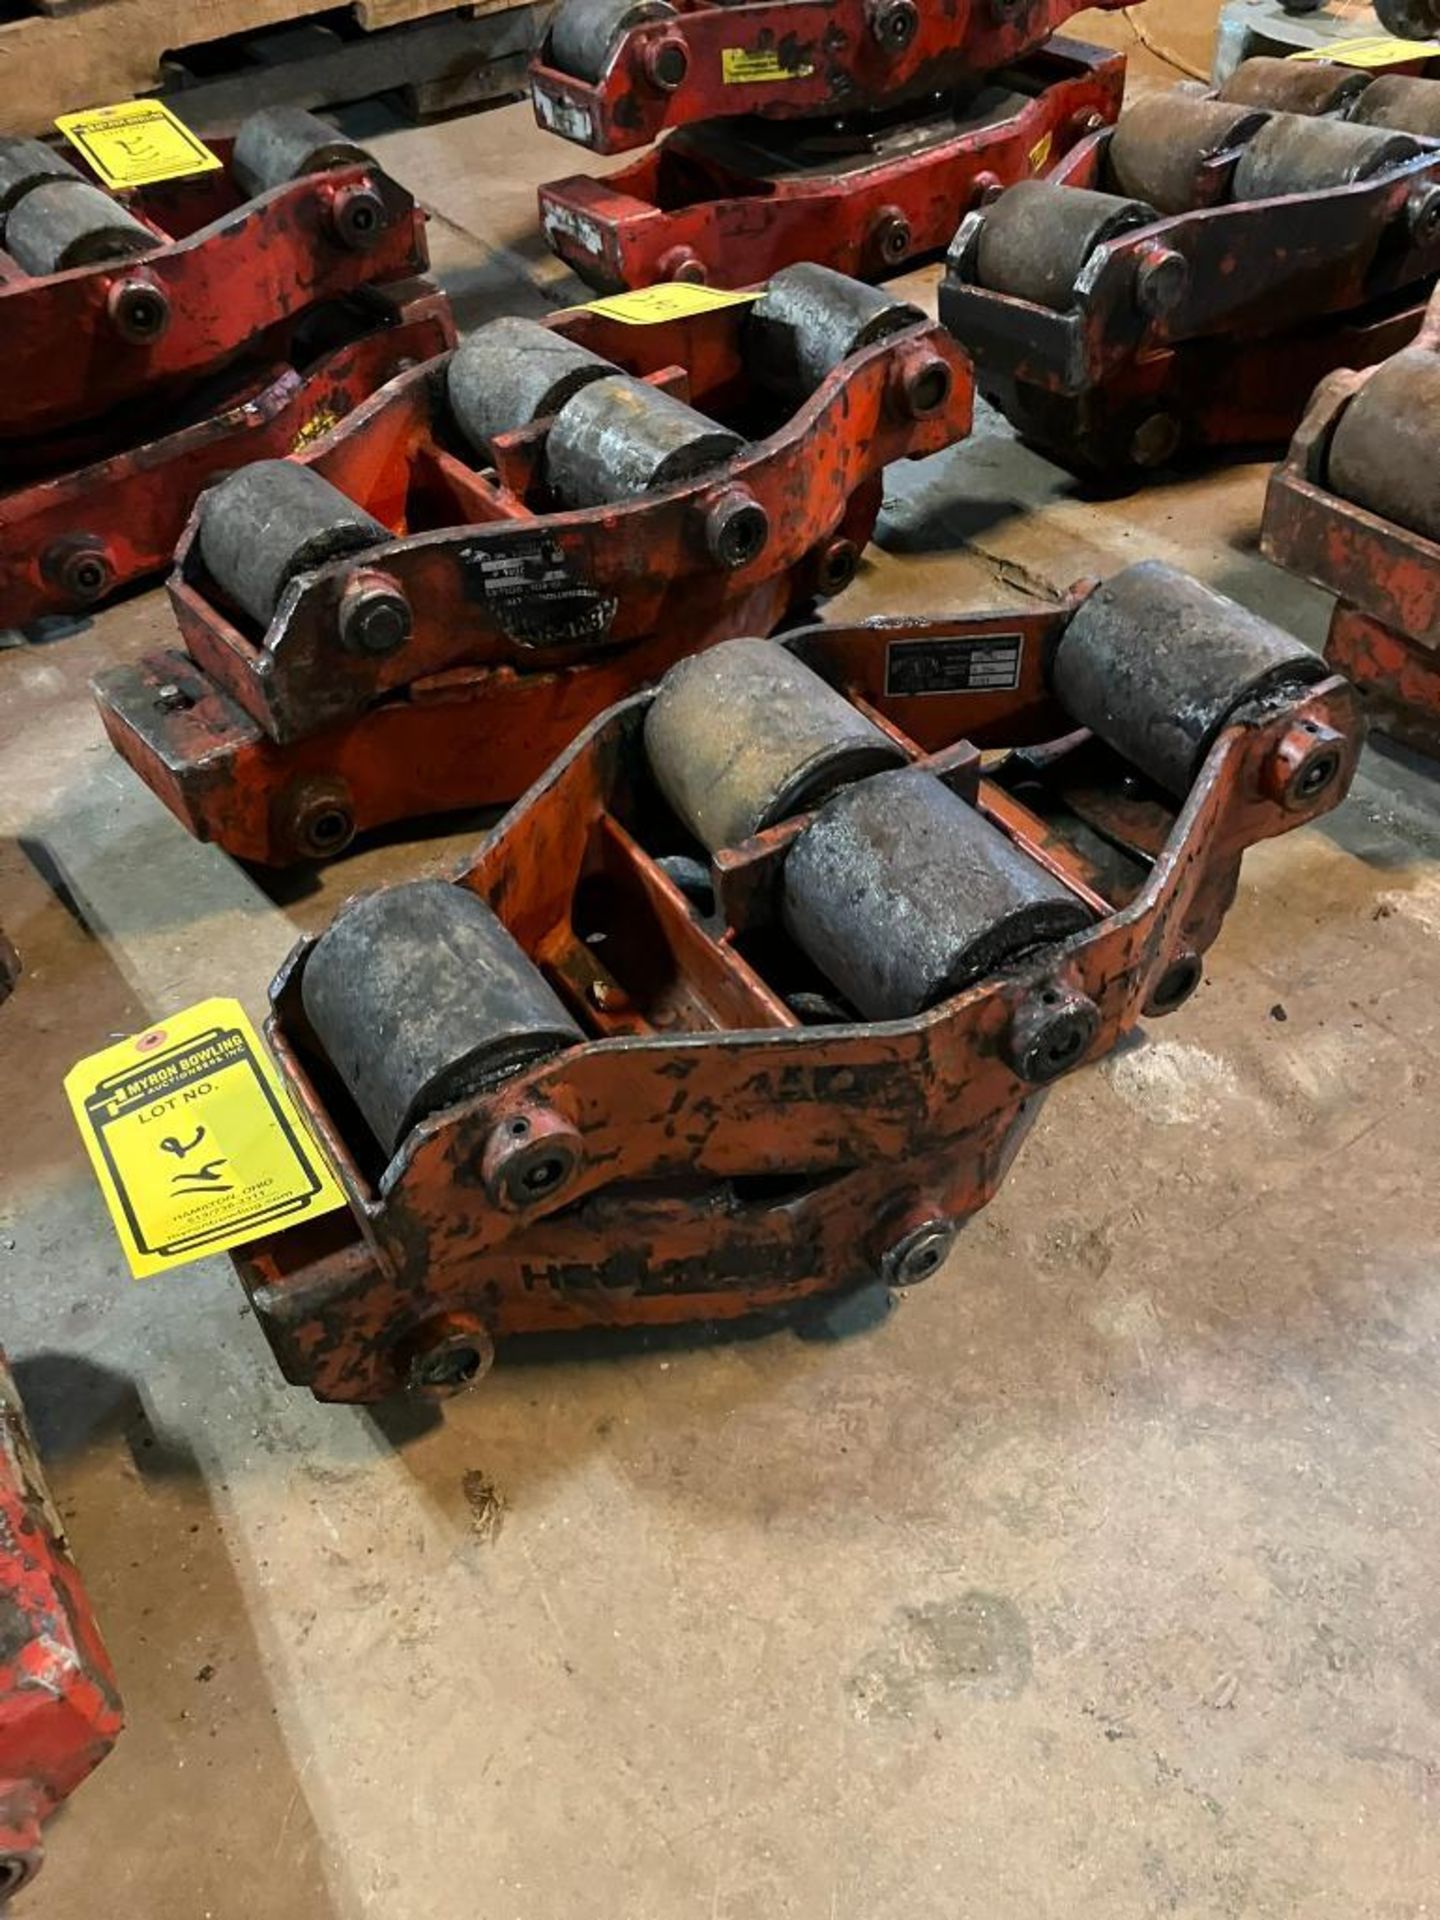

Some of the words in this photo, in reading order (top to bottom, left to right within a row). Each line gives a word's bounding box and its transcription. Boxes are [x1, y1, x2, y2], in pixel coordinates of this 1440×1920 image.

[126, 1063, 178, 1096] MYRON
[178, 1034, 244, 1072] BOWLING
[138, 1098, 177, 1125] LOT
[182, 1081, 220, 1104] NO.
